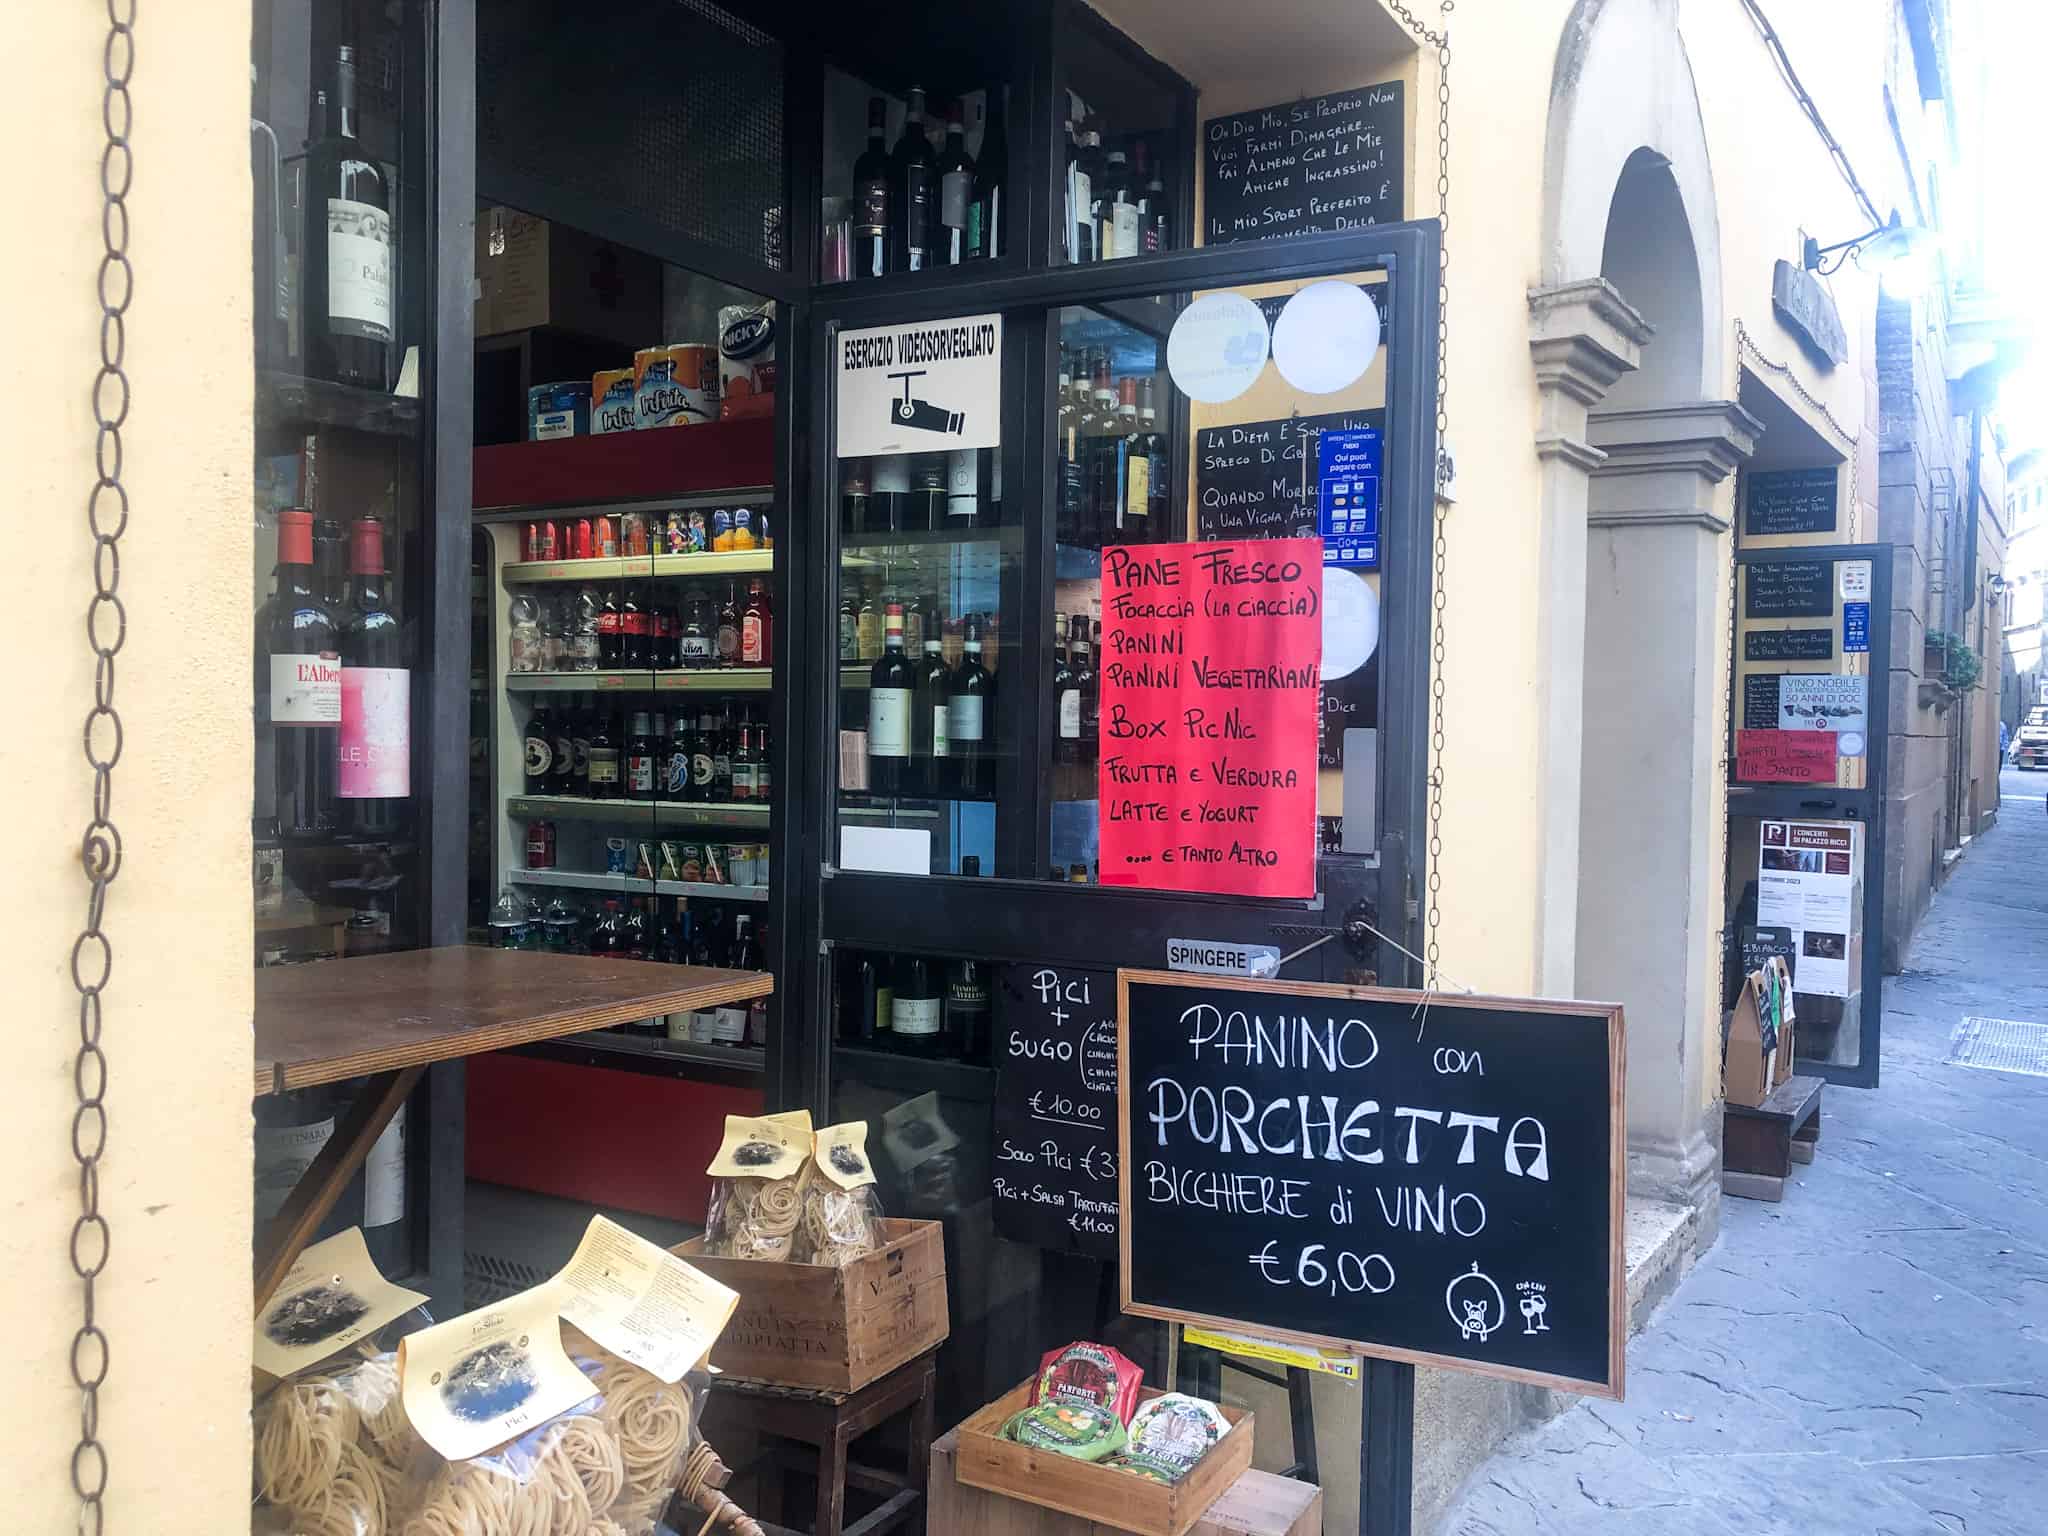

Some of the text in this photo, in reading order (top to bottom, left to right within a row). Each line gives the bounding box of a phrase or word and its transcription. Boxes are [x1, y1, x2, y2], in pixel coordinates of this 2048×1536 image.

[844, 323, 995, 371] ESERCIZIO VIDEOSORVEGLIATO
[1329, 462, 1371, 473] pagare con
[1334, 452, 1367, 463] Qui puoi
[1104, 548, 1302, 588] PANE FRESCO
[1786, 679, 1861, 688] VINO NOBILE
[1786, 695, 1799, 703] 50
[1800, 695, 1824, 703] ANNI
[1827, 695, 1836, 703] DI
[1104, 756, 1177, 784] FRUTTA
[1211, 757, 1297, 788] VERDURA
[1109, 800, 1169, 822] LATTE
[1198, 801, 1259, 824] YOGURT
[1179, 846, 1223, 863] TANTO
[1228, 840, 1278, 867] ALTRO
[1802, 837, 1829, 845] PALAZZO
[1169, 946, 1247, 970] SPINGERE
[1008, 1031, 1073, 1062] SUGO
[1179, 1003, 1486, 1076] PANINO con
[1146, 1076, 1551, 1182] PORCHETTA
[1144, 1160, 1486, 1237] BICCHIERE di VINO
[1056, 1382, 1098, 1400] PANFORTE
